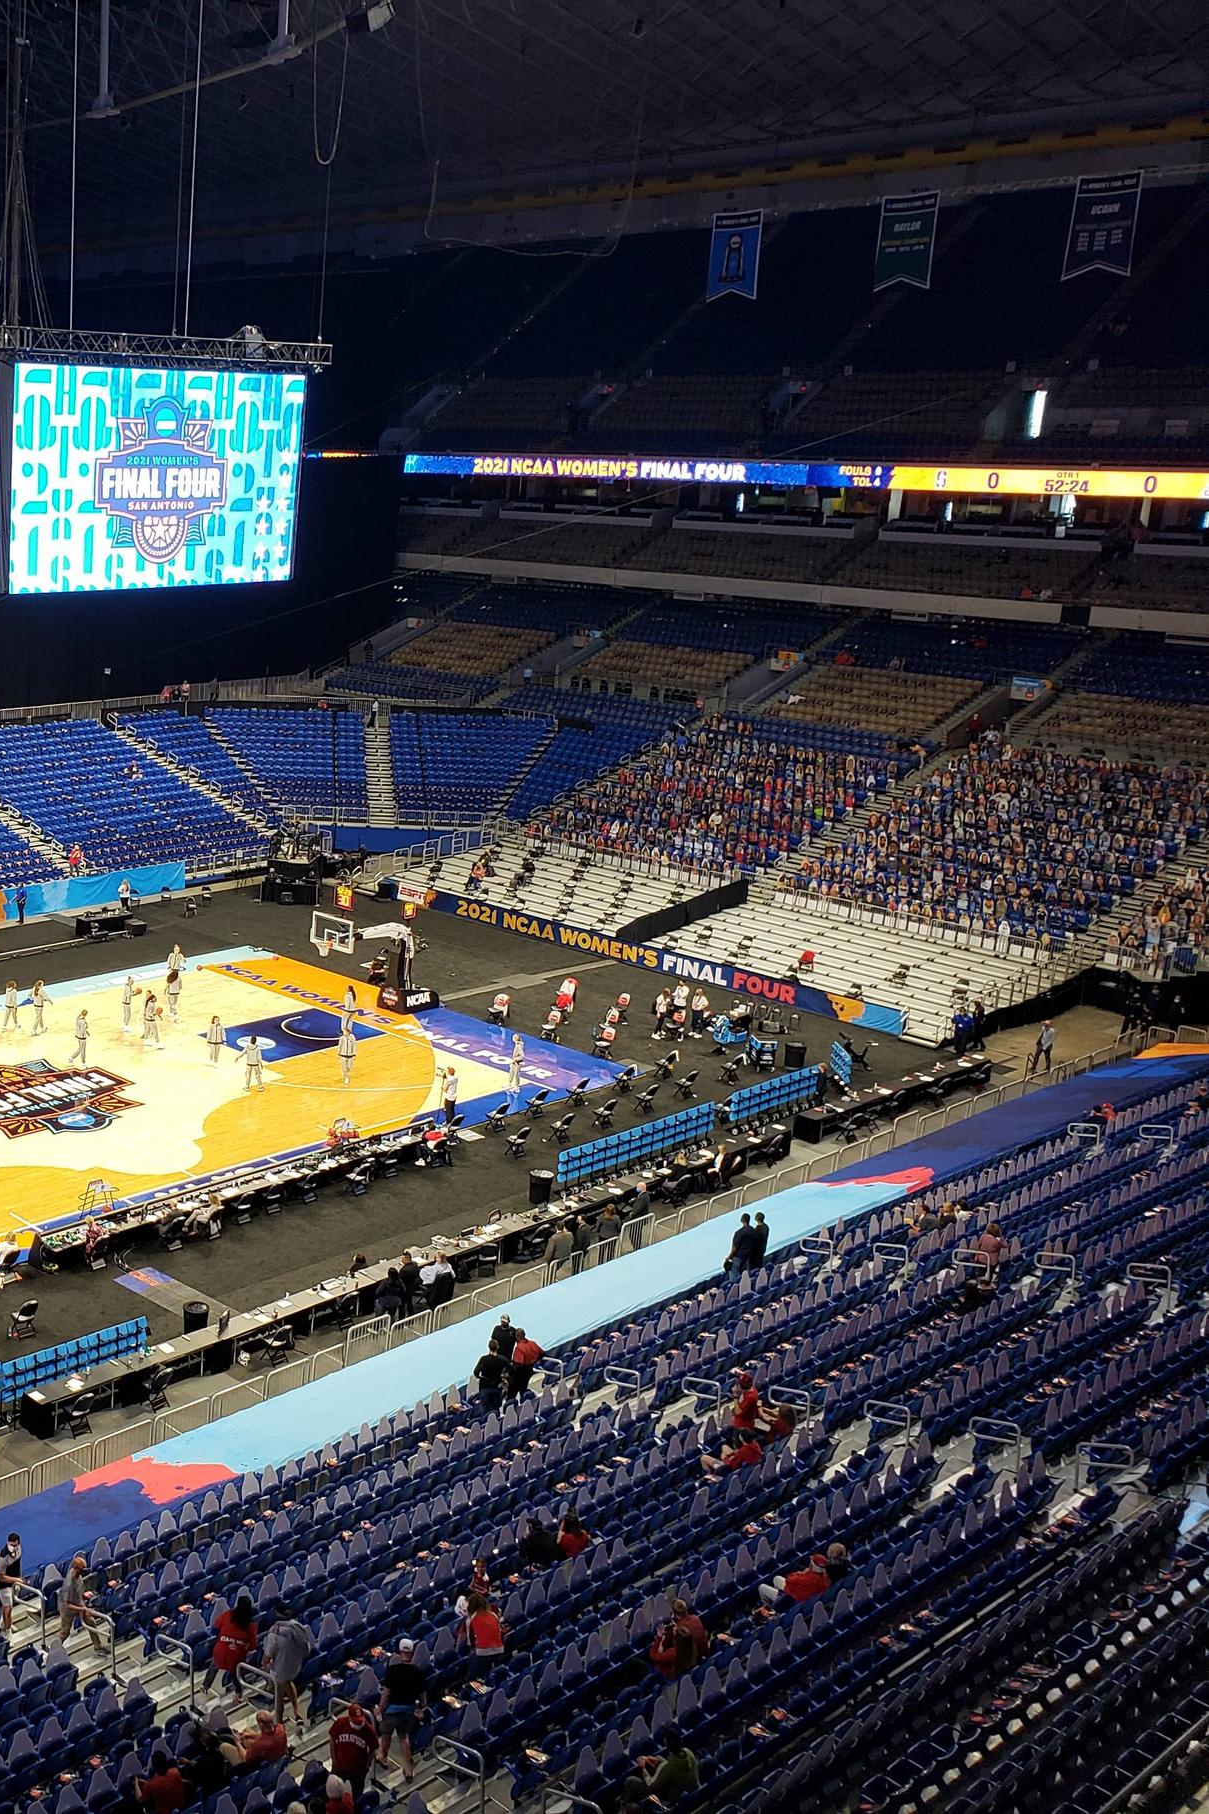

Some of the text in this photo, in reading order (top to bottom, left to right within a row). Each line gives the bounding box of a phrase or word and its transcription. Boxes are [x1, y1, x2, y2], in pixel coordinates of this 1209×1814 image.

[126, 456, 199, 466] 2021 WOMEN'S
[473, 457, 746, 482] 2021 NCAA WOMEN'S FINAL FOUR
[839, 465, 872, 476] FOULS
[102, 467, 221, 499] FINAL FOUR
[852, 477, 881, 487] TOL 4
[987, 472, 999, 489] 0
[1044, 479, 1090, 494] 52:24
[1144, 475, 1158, 493] 0
[127, 500, 195, 511] SAN ANTONIO
[456, 900, 797, 1005] 2021 NCAA WOMEN'S FINAL FOUR
[217, 963, 278, 987] NCAA
[406, 991, 431, 1008] NCAA
[392, 1022, 470, 1052] FINAL
[19, 1072, 117, 1101] FINAL
